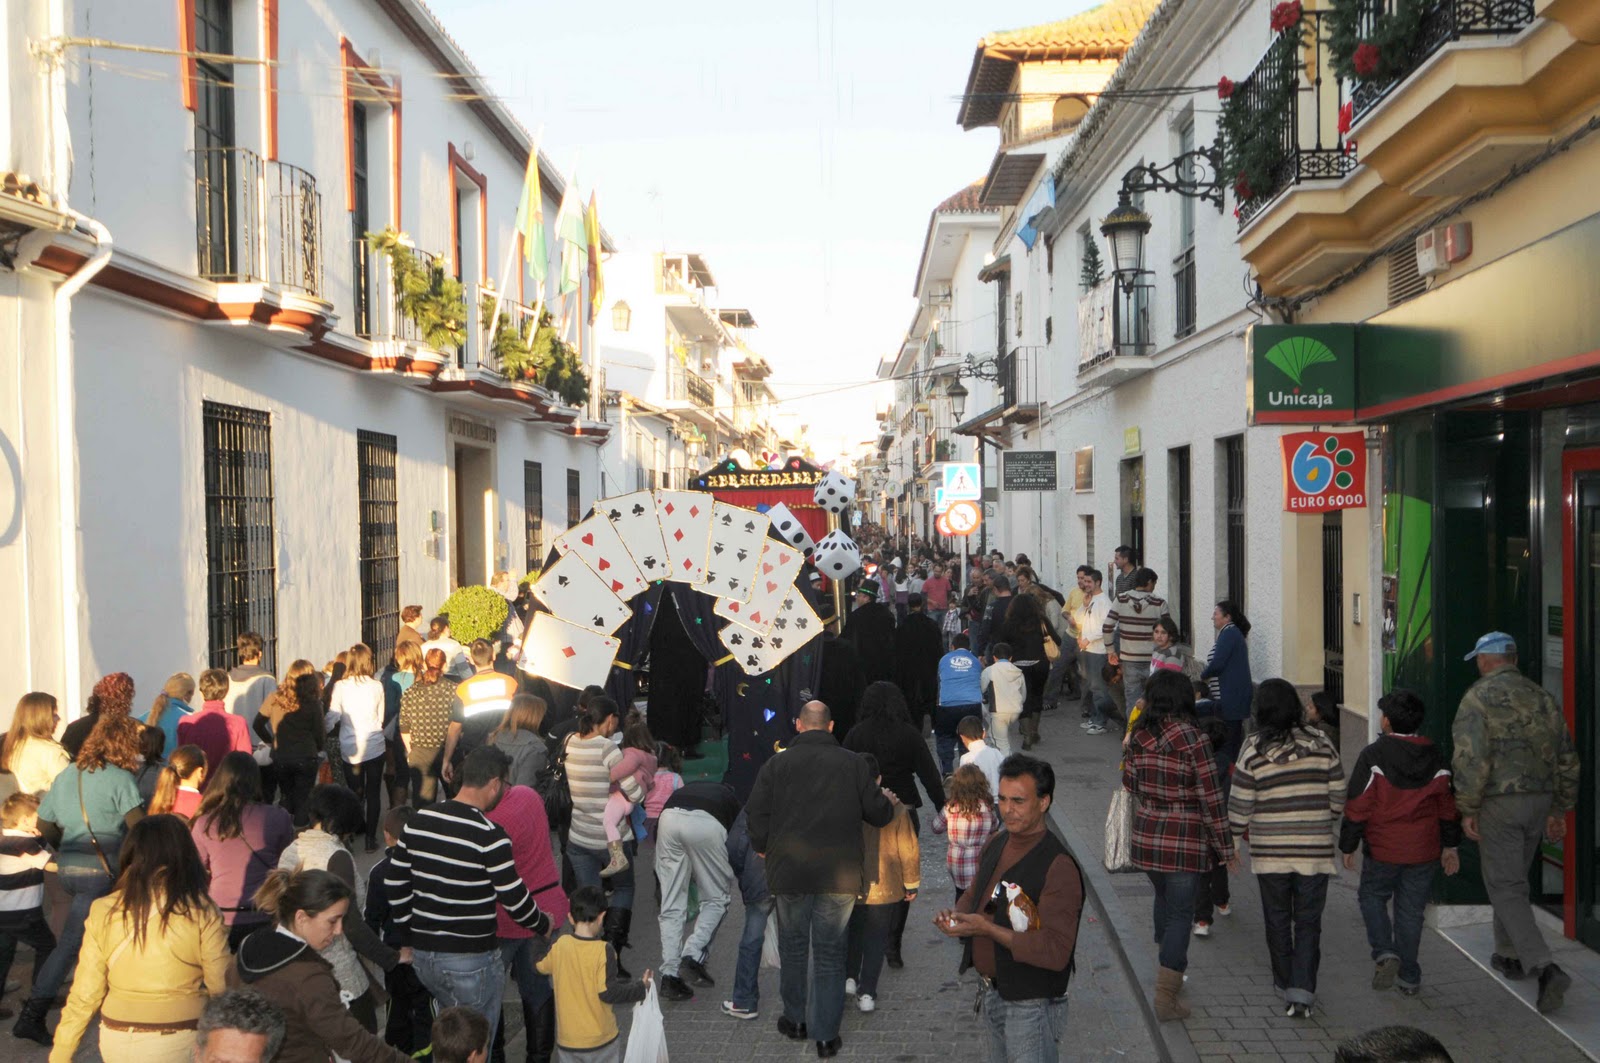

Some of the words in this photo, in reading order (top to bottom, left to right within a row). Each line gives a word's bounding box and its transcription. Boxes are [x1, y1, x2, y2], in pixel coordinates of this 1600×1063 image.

[1268, 387, 1333, 408] Unicaja
[1291, 496, 1325, 508] EURO
[1328, 494, 1363, 506] 6000
